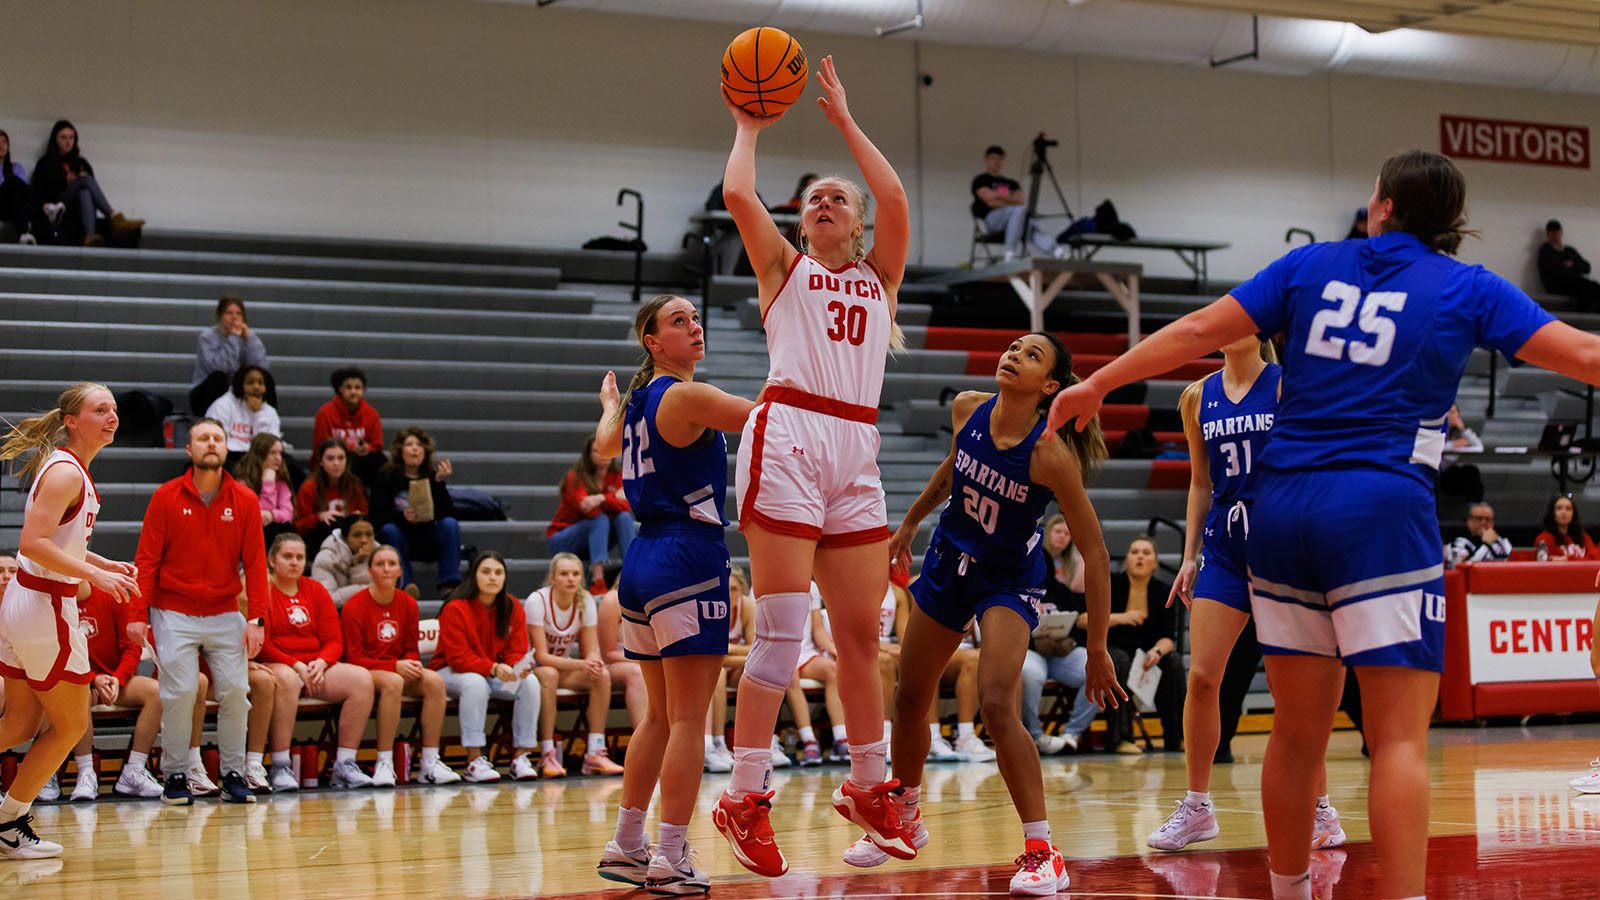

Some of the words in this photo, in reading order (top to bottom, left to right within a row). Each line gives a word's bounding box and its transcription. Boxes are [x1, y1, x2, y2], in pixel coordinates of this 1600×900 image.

[1444, 120, 1585, 164] VISITORS
[808, 273, 882, 301] DUTCH
[826, 299, 868, 347] 30
[1304, 279, 1408, 367] 25
[622, 415, 656, 480] 22
[1203, 413, 1274, 441] SPARTANS
[954, 448, 1030, 503] SPARTANS
[1220, 439, 1252, 477] 31
[962, 485, 1000, 535] 20
[1489, 618, 1594, 654] CENTR
